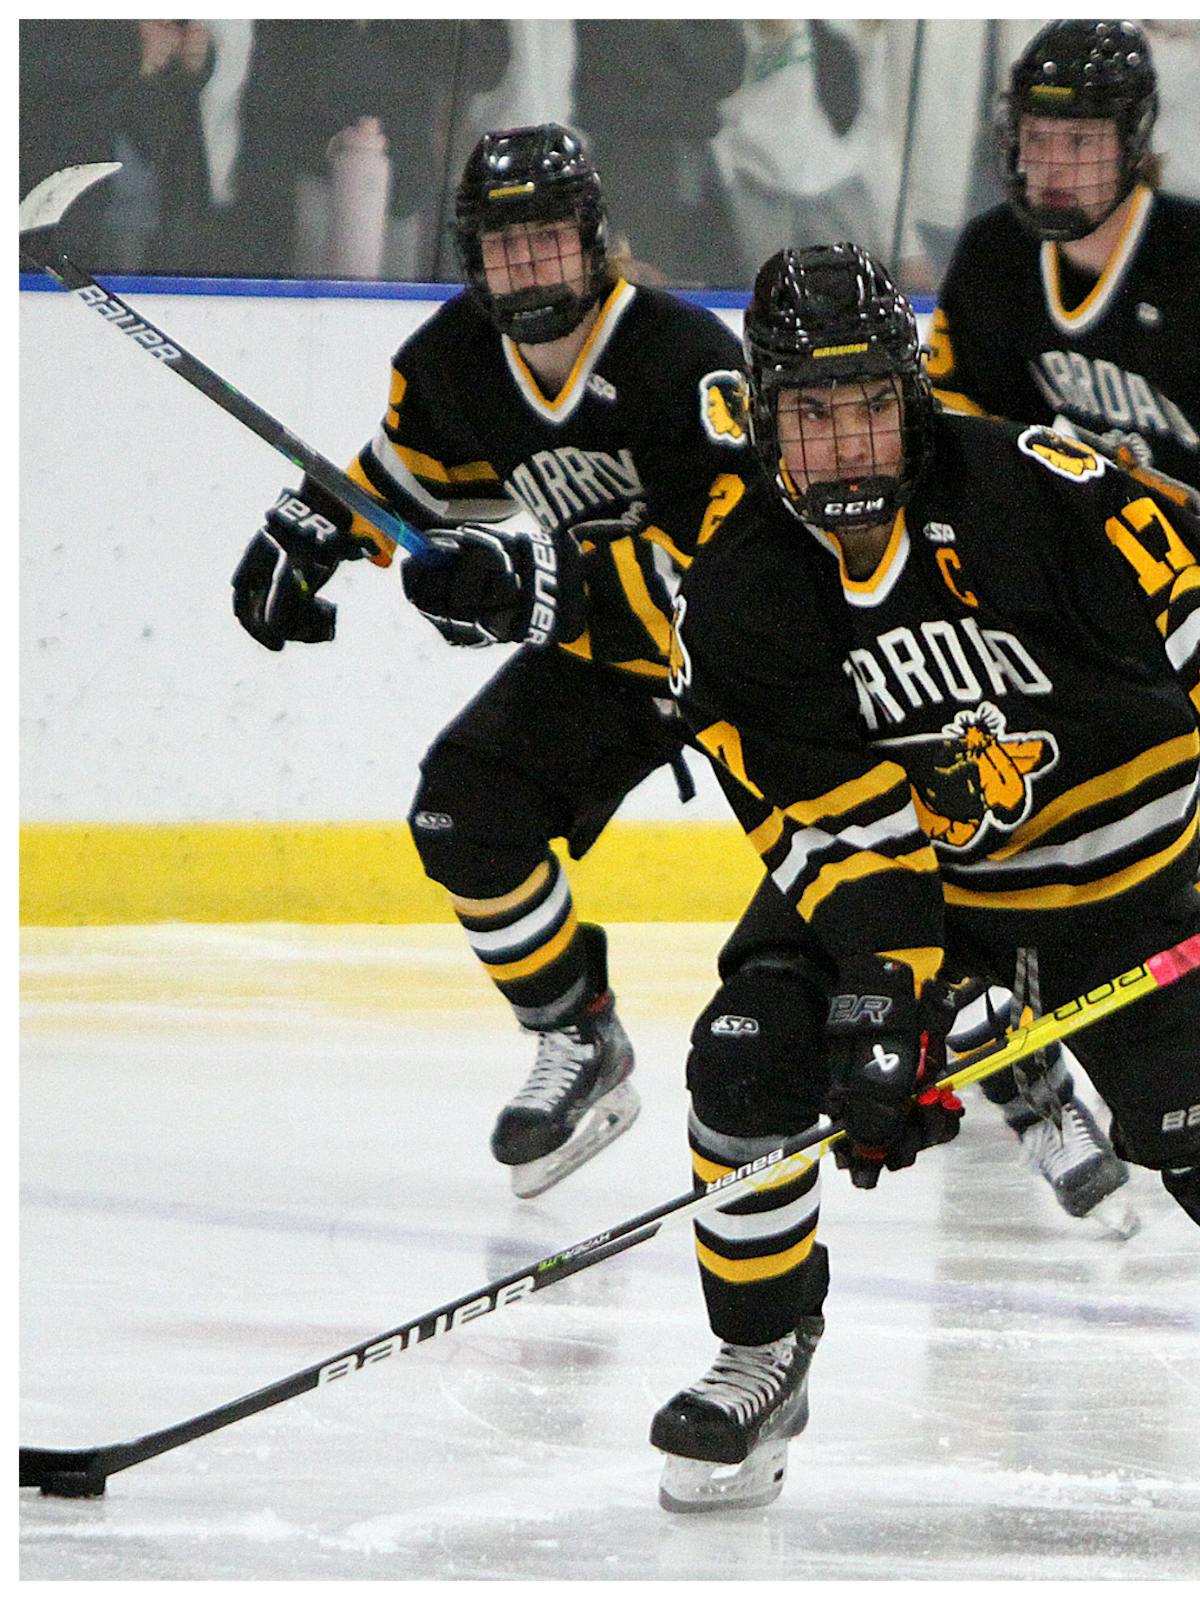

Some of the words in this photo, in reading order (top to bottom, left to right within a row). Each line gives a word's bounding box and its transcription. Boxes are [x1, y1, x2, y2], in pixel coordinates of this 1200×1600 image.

[72, 284, 182, 362] BAUER
[824, 497, 884, 516] CCM
[935, 547, 979, 607] C
[1104, 497, 1197, 597] 17
[706, 1148, 783, 1194] BAUER
[318, 1274, 537, 1387] BAUER
